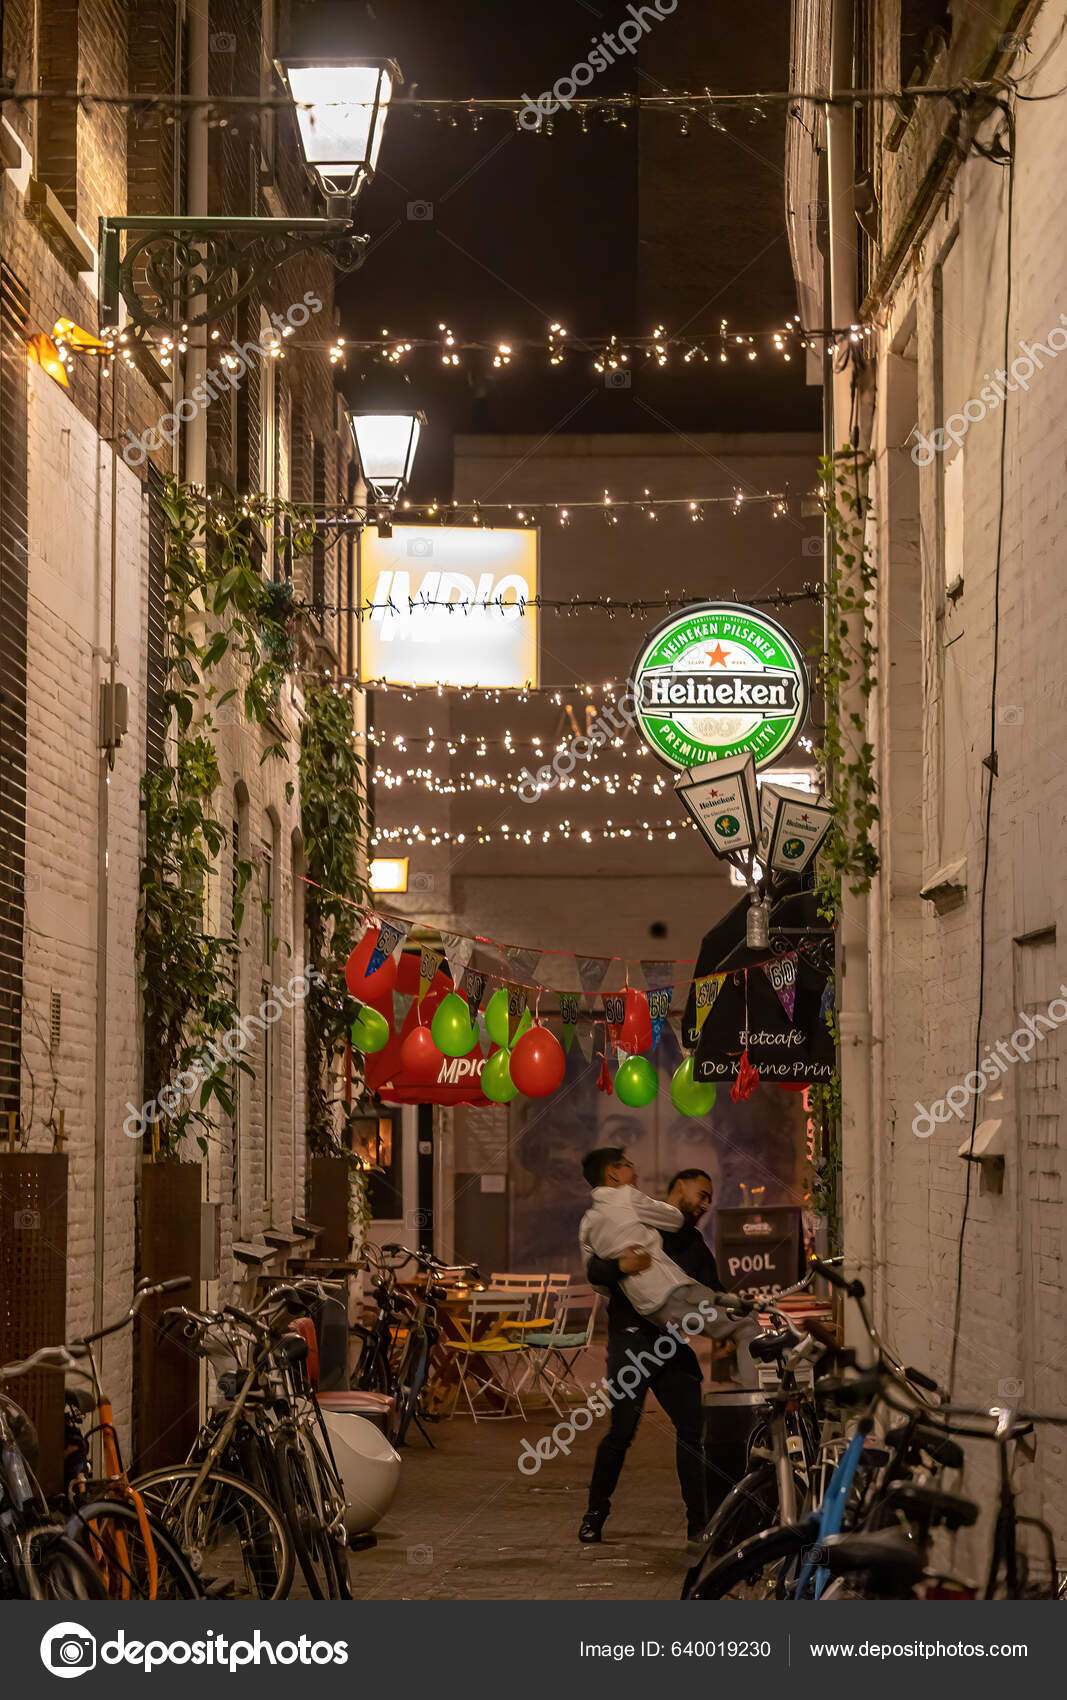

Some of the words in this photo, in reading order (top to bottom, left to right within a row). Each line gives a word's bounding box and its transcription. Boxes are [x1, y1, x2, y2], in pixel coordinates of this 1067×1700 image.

[661, 623, 718, 660] HEINEKEN
[723, 623, 776, 660] PILSENER
[650, 677, 789, 705] Heineken
[659, 724, 718, 763] PREMIUM
[377, 928, 400, 957] 60
[420, 952, 438, 980] 60
[770, 959, 796, 992] 60
[509, 991, 528, 1017] 60
[649, 991, 670, 1020] 60
[702, 1061, 729, 1076] De
[731, 1062, 790, 1075] Keine
[728, 1253, 776, 1277] POOL
